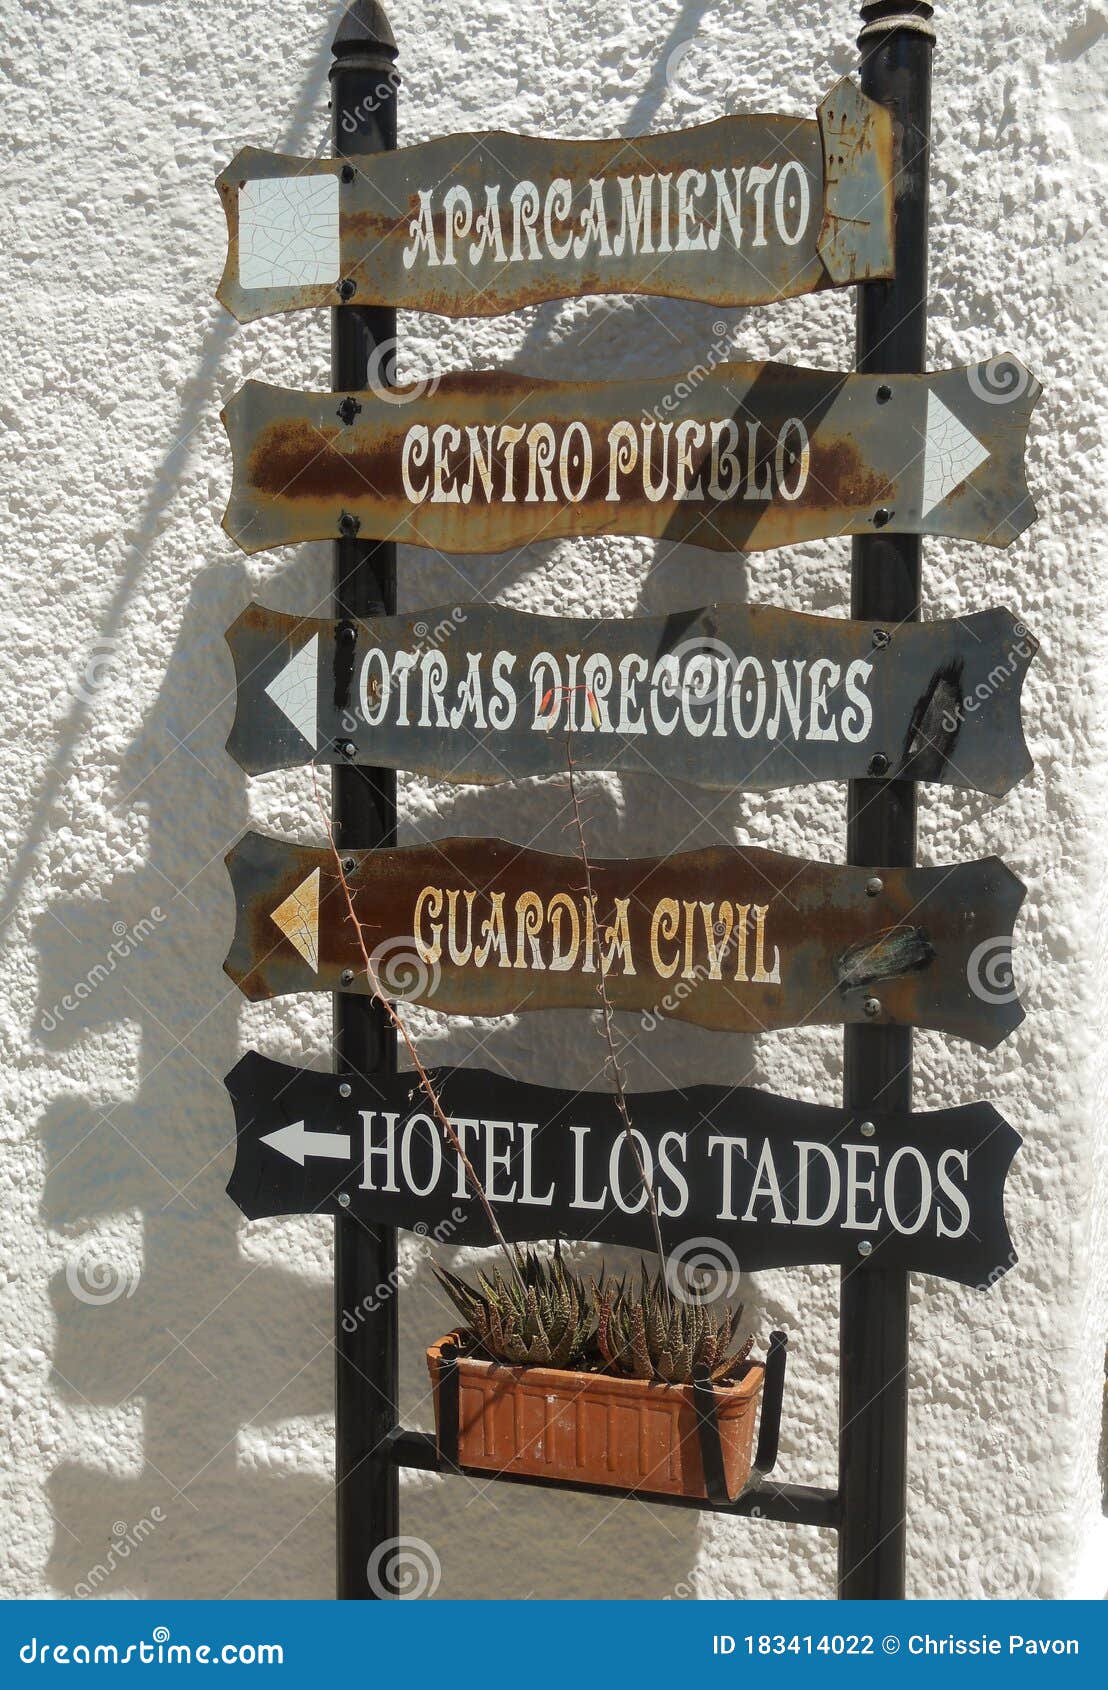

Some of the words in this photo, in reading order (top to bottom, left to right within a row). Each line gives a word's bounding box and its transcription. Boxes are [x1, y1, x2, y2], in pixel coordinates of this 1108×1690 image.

[403, 160, 810, 270] APARCAMIENTO
[401, 420, 593, 505] CENTRO
[605, 417, 809, 503] PUEBLO
[359, 647, 518, 729] OTRAS
[529, 651, 874, 744] DIRECCIONES
[413, 885, 637, 977] GUARDIA
[650, 897, 782, 985] CIVIL
[358, 1110, 555, 1207] HOTEL
[568, 1125, 690, 1218] LOS
[707, 1135, 971, 1240] TADEOS
